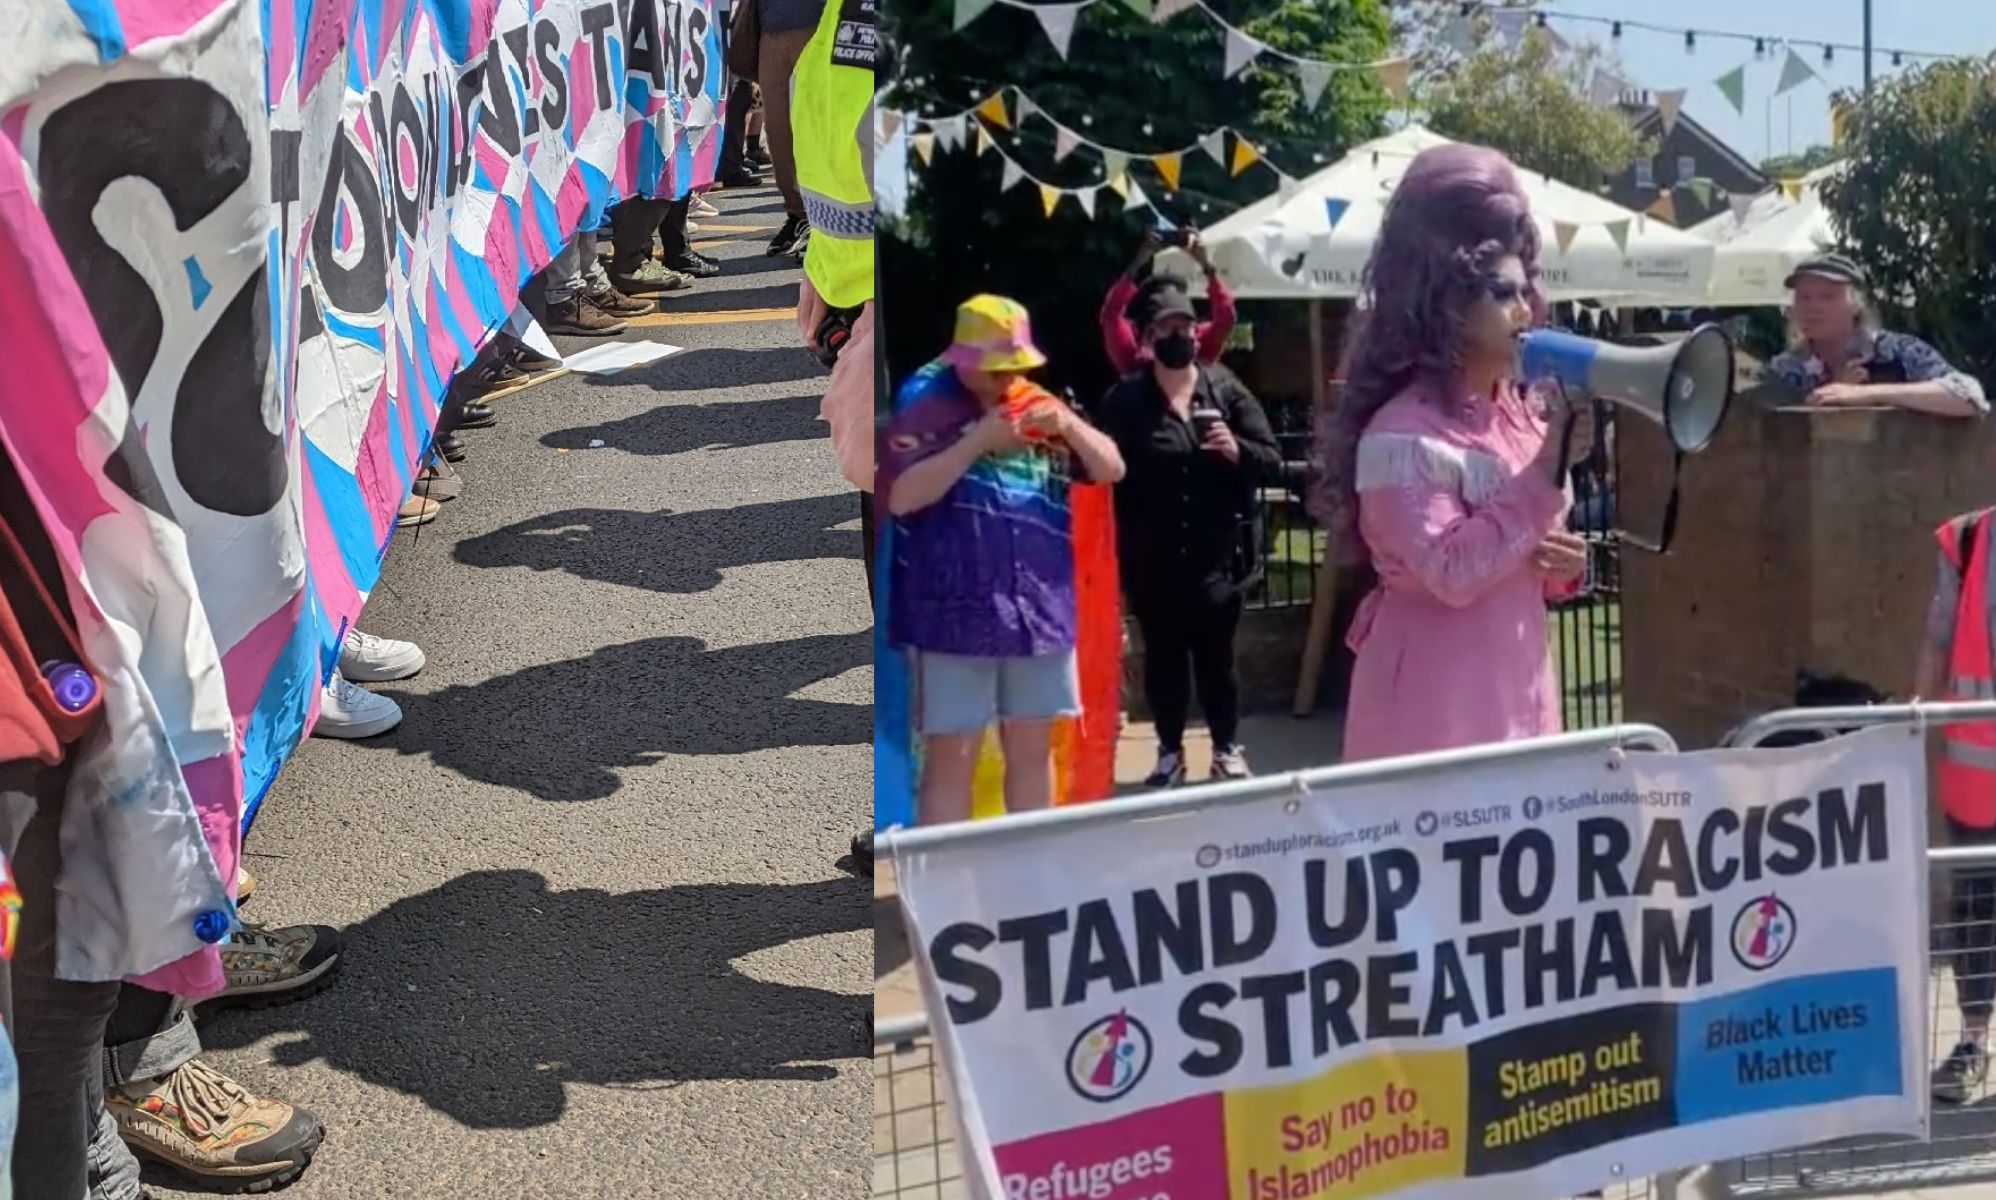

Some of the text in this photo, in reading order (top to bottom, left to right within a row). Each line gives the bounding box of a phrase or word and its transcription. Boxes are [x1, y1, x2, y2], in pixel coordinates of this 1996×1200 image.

[929, 781, 1889, 1025] STAND UP TO RACISM
[1178, 906, 1713, 1079] STREATHAM
[1705, 1001, 1868, 1052] Black Lives
[1499, 1032, 1643, 1099] Stamp out
[1736, 1046, 1836, 1085] Matter
[1280, 1081, 1418, 1153] Say no to
[1483, 1075, 1661, 1149] antisemitism
[1002, 1143, 1173, 1200] Refugees
[1247, 1119, 1450, 1200] Islamophobia
